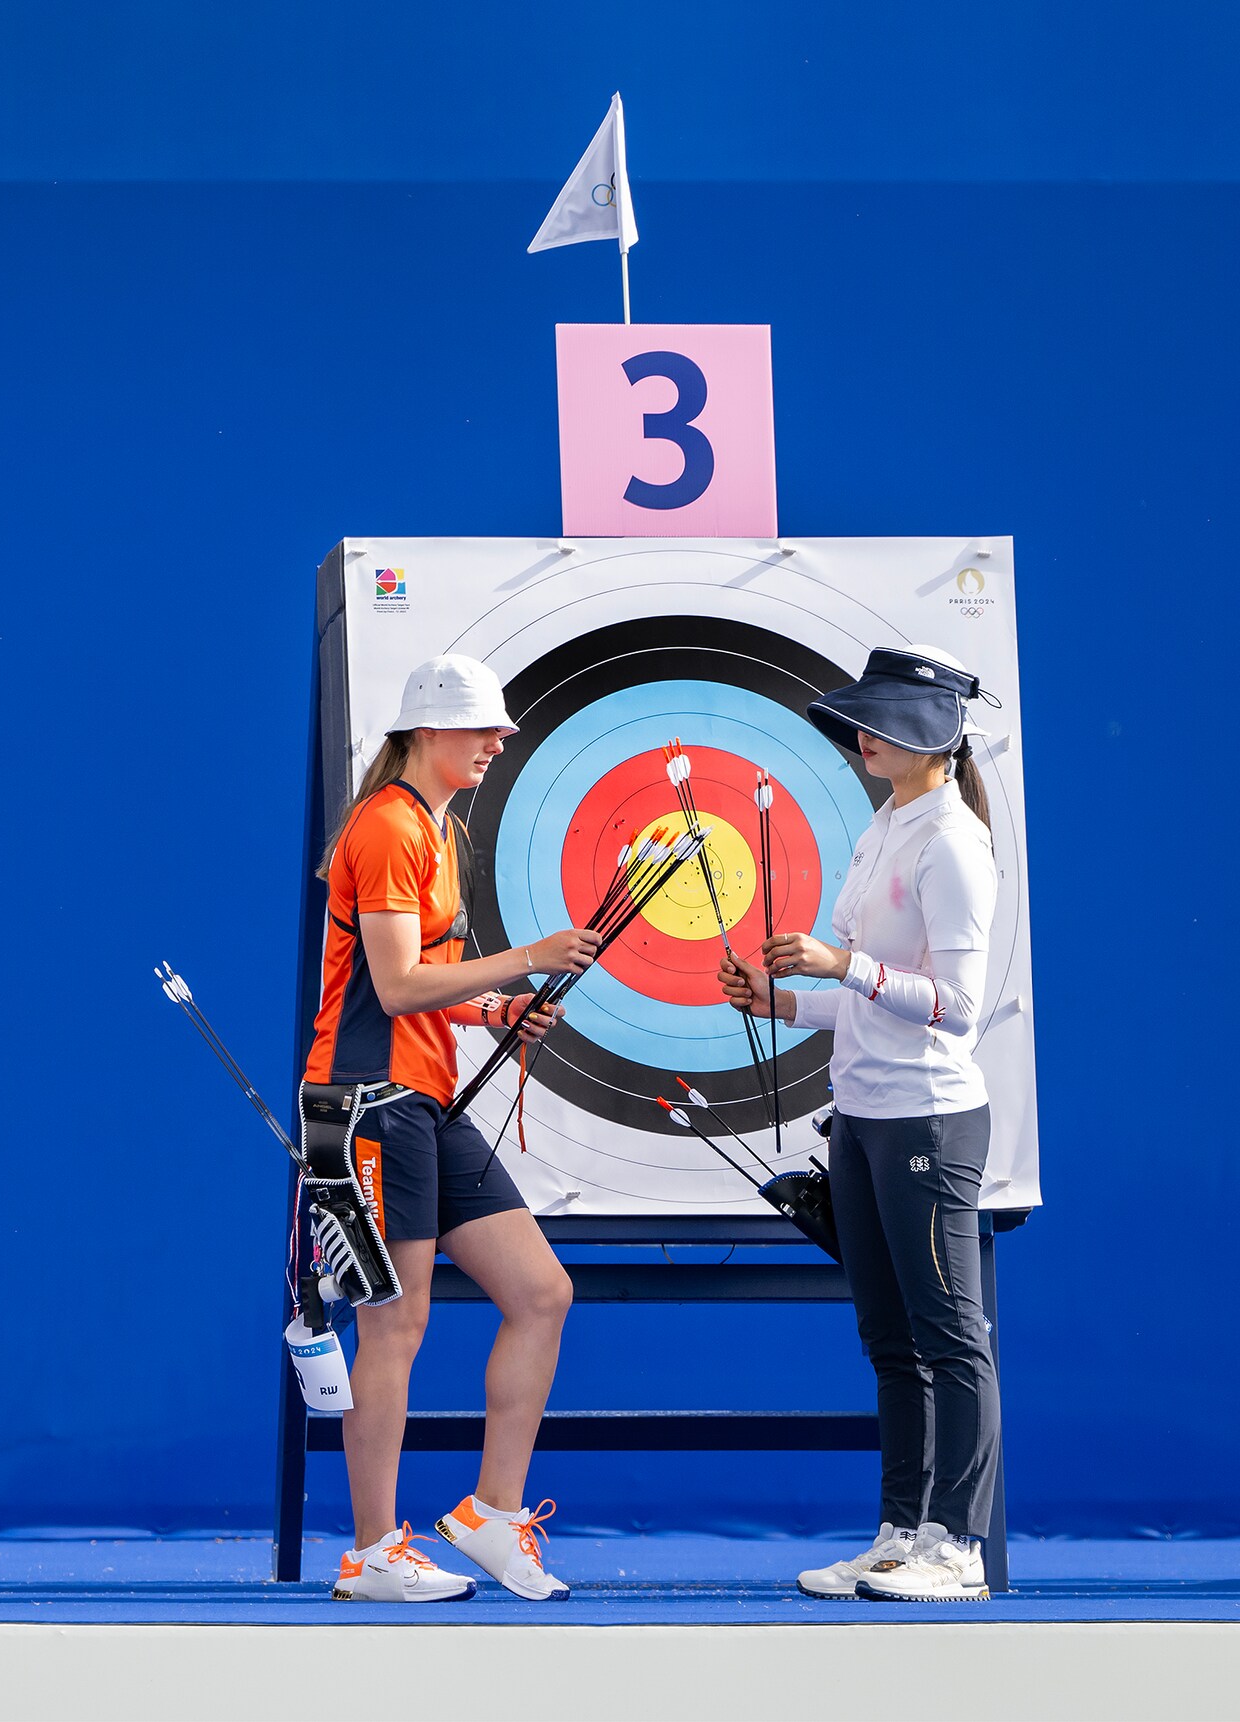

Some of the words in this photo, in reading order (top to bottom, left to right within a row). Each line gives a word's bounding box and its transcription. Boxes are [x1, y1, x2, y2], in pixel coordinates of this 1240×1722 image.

[621, 350, 715, 510] 3
[736, 870, 743, 880] 9
[802, 870, 809, 880] 7
[835, 870, 842, 880] 6
[1000, 869, 1004, 879] 1
[298, 1346, 321, 1355] 2024
[320, 1385, 338, 1395] RW
